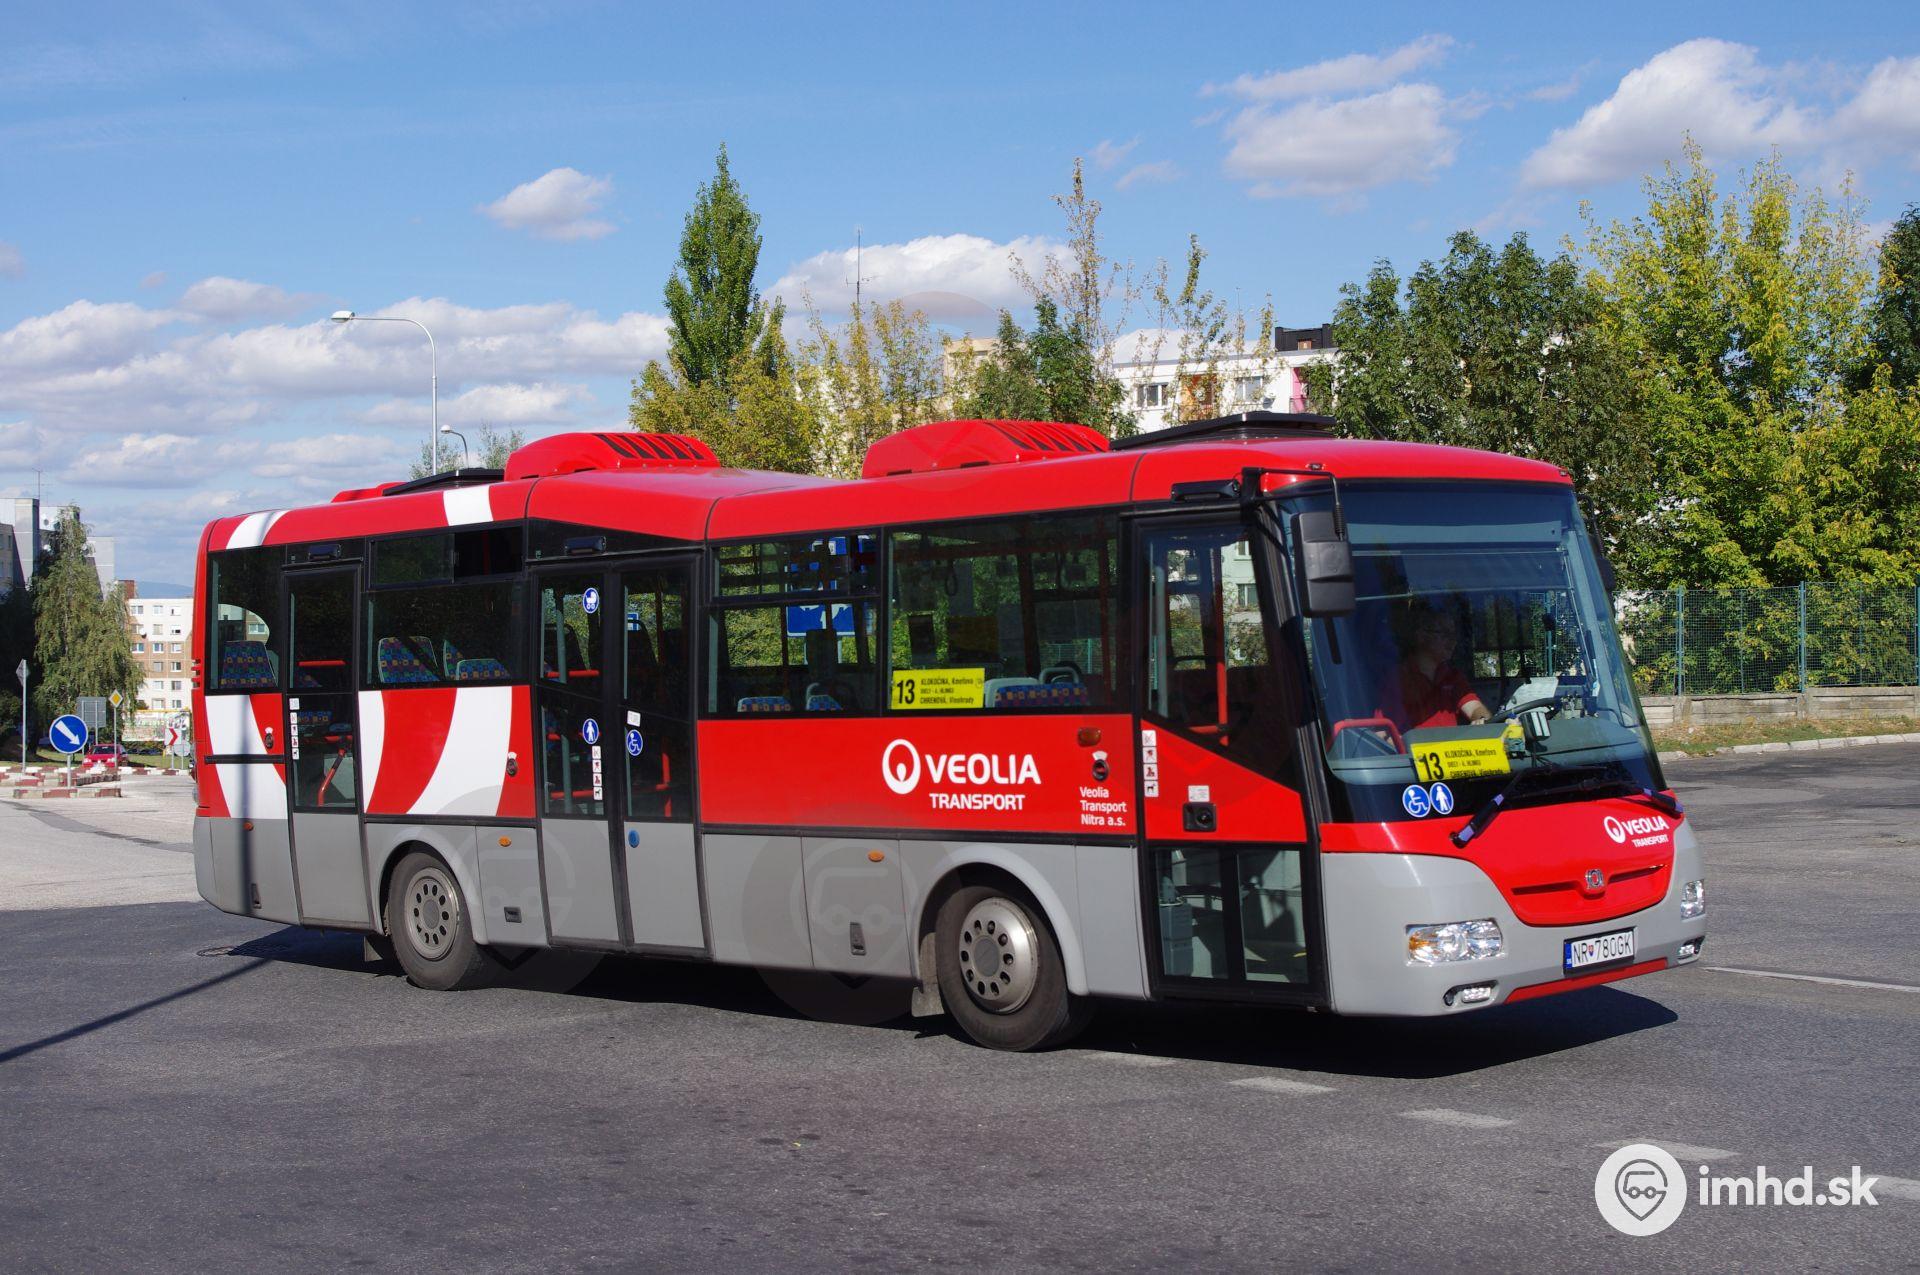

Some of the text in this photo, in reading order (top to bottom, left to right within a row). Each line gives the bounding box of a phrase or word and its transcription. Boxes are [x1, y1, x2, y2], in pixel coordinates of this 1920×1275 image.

[896, 679, 915, 704] 13
[925, 753, 1041, 785] VEOLIA
[1418, 752, 1444, 780] 13
[1079, 786, 1109, 798] Veolia
[929, 793, 1026, 811] TRANSPORT
[1080, 800, 1128, 813] Transport
[1081, 813, 1126, 827] Nitra a.s.
[1621, 815, 1670, 836] VEOLIA
[1631, 834, 1669, 848] TRANSPORT
[1573, 942, 1588, 964] NR
